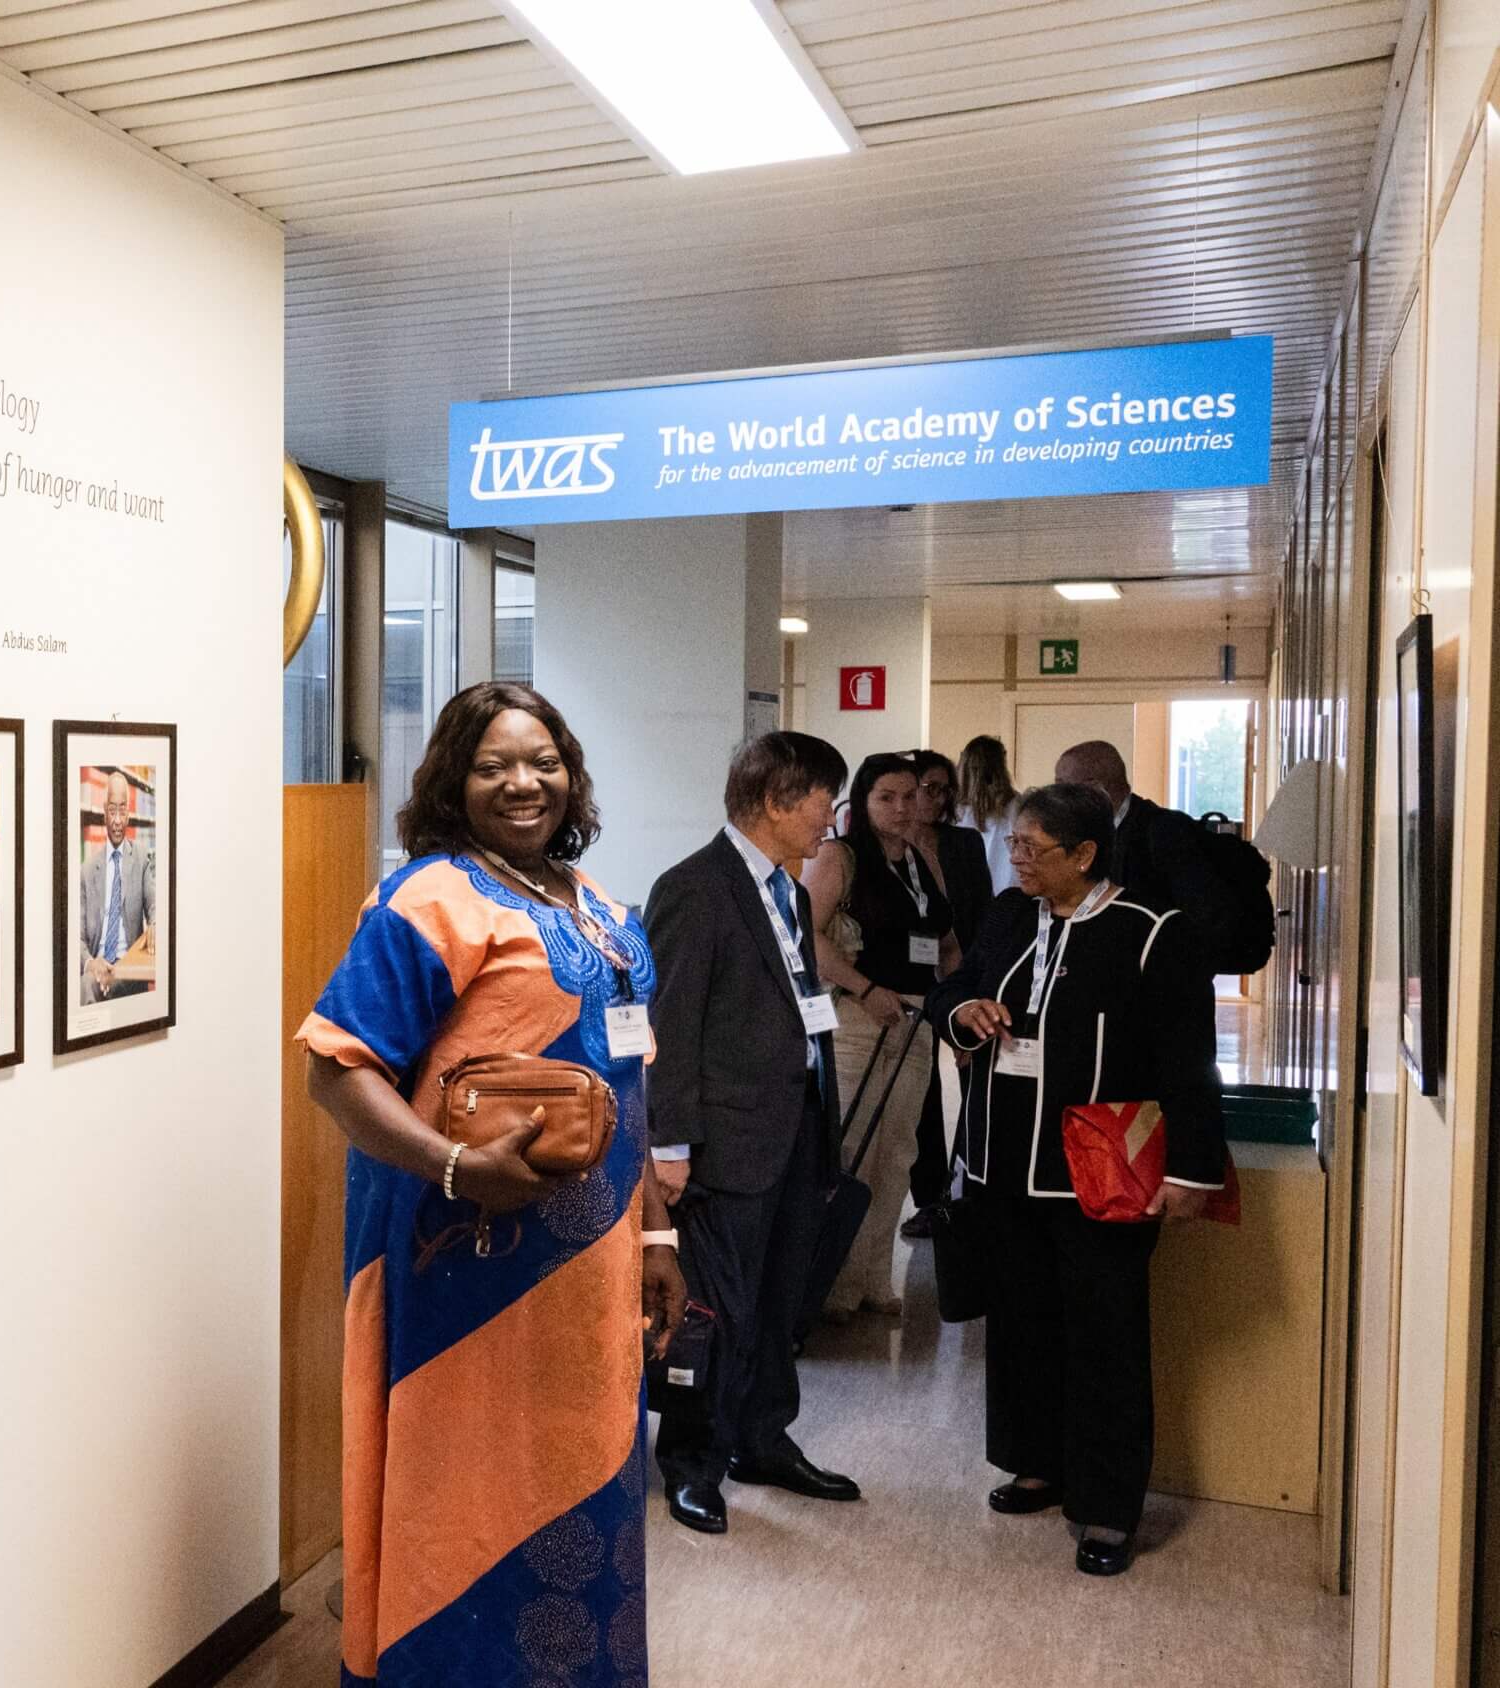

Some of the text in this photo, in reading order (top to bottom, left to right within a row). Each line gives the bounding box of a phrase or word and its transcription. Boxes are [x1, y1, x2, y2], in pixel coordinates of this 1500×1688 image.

[658, 390, 1237, 457] The World Academy of Sciences
[16, 454, 83, 510] hunger
[86, 479, 118, 513] and
[123, 491, 165, 524] want
[468, 427, 626, 502] twas
[654, 427, 1235, 490] for the advancement of science in developing countries
[1, 629, 68, 655] Abdus Salam
